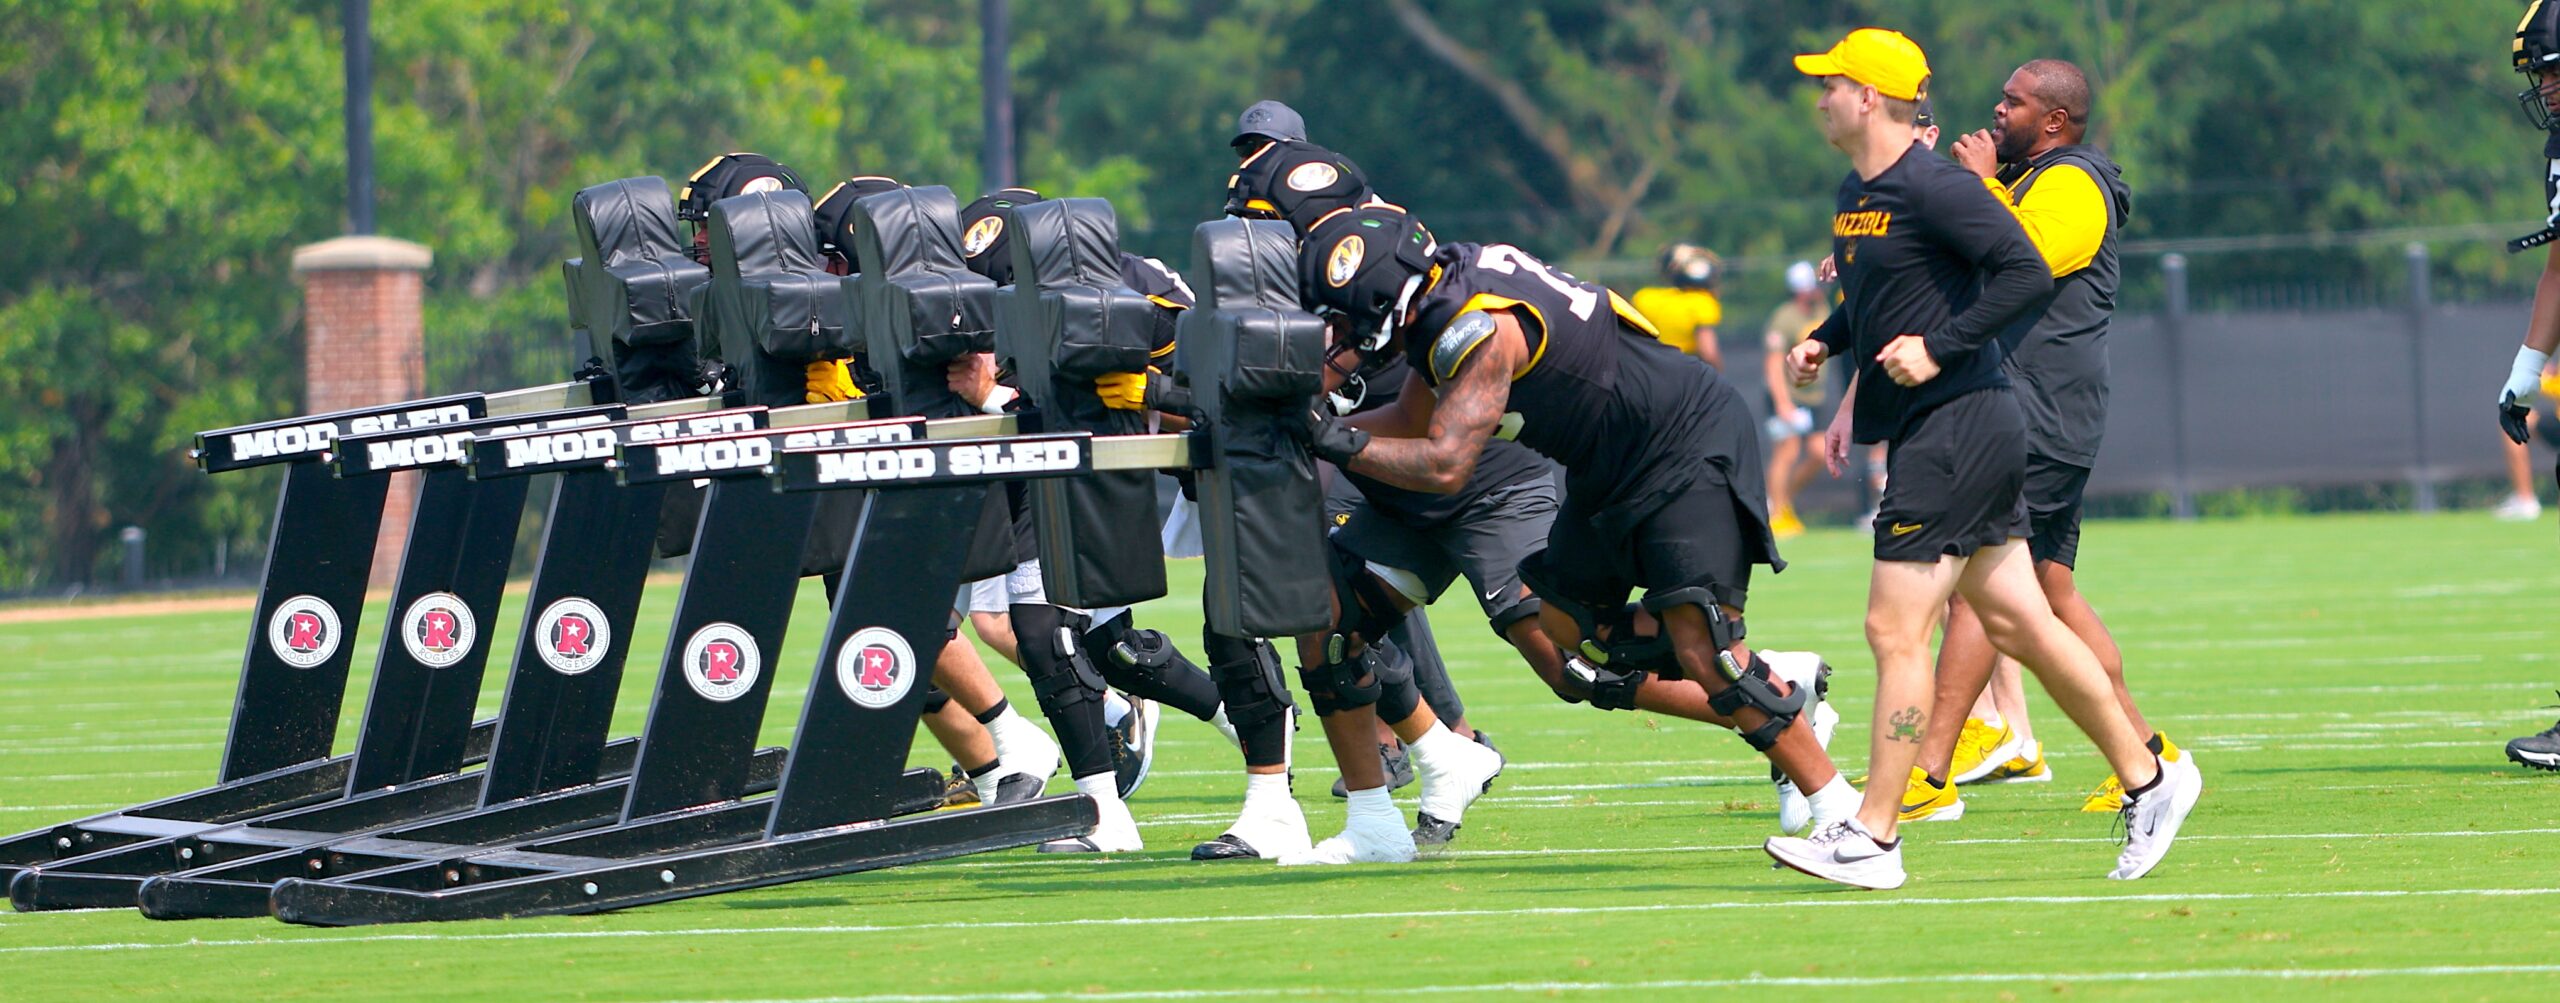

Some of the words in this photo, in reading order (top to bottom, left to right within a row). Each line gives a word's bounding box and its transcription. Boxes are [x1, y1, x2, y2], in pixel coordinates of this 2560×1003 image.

[231, 421, 339, 461] MOD
[367, 431, 478, 470] MOD
[504, 429, 618, 468] MOD
[657, 437, 773, 475] MOD
[817, 448, 936, 483] MOD
[949, 440, 1080, 475] SLED
[289, 613, 321, 650] R
[423, 611, 455, 648] R
[556, 616, 589, 655] R
[282, 647, 324, 662] ROGERS
[418, 647, 460, 661] ROGERS
[550, 652, 593, 668] ROGERS
[706, 643, 738, 681] R
[859, 648, 894, 687] R
[701, 680, 745, 695] ROGERS
